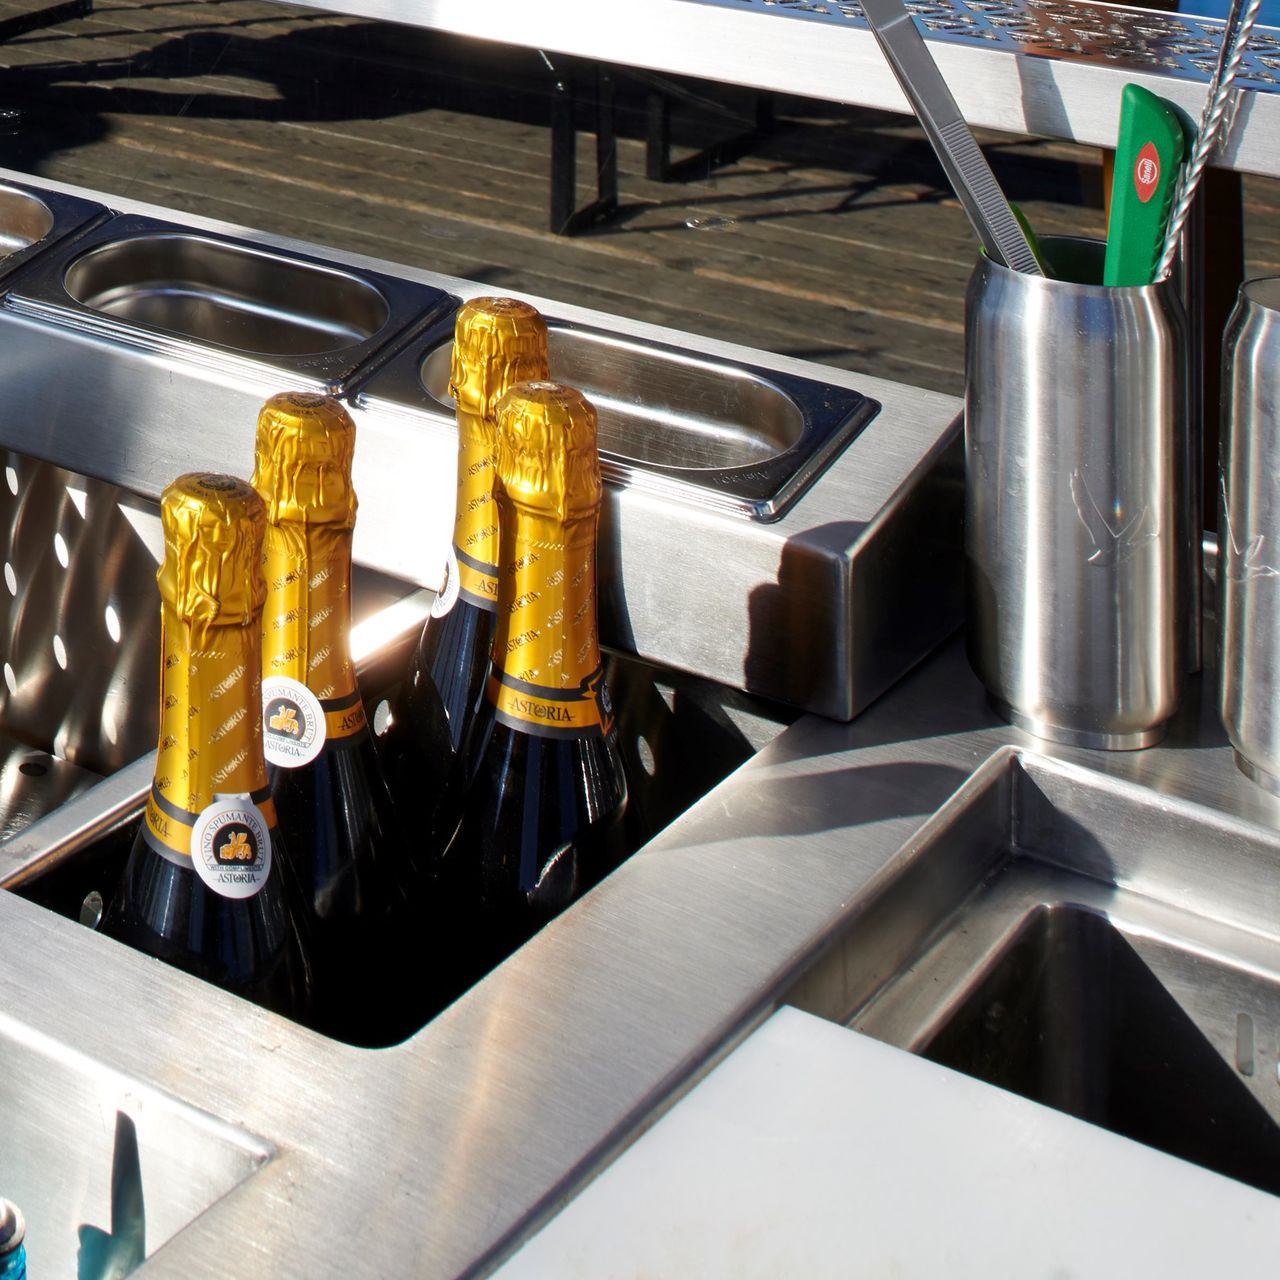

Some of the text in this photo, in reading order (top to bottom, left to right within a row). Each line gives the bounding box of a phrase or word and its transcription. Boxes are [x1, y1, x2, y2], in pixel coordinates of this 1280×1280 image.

[466, 524, 499, 547] ASTORIA
[505, 629, 539, 655] ASTORIA
[208, 664, 246, 702] ASTORIA
[511, 697, 573, 722] ASTORIA
[208, 707, 247, 745] ASTORIA
[265, 740, 301, 757] ASTORIA
[210, 748, 248, 787] ASTORIA
[204, 812, 264, 863] VINO SPUMANTE BRUT
[218, 873, 257, 883] ASTORIA
